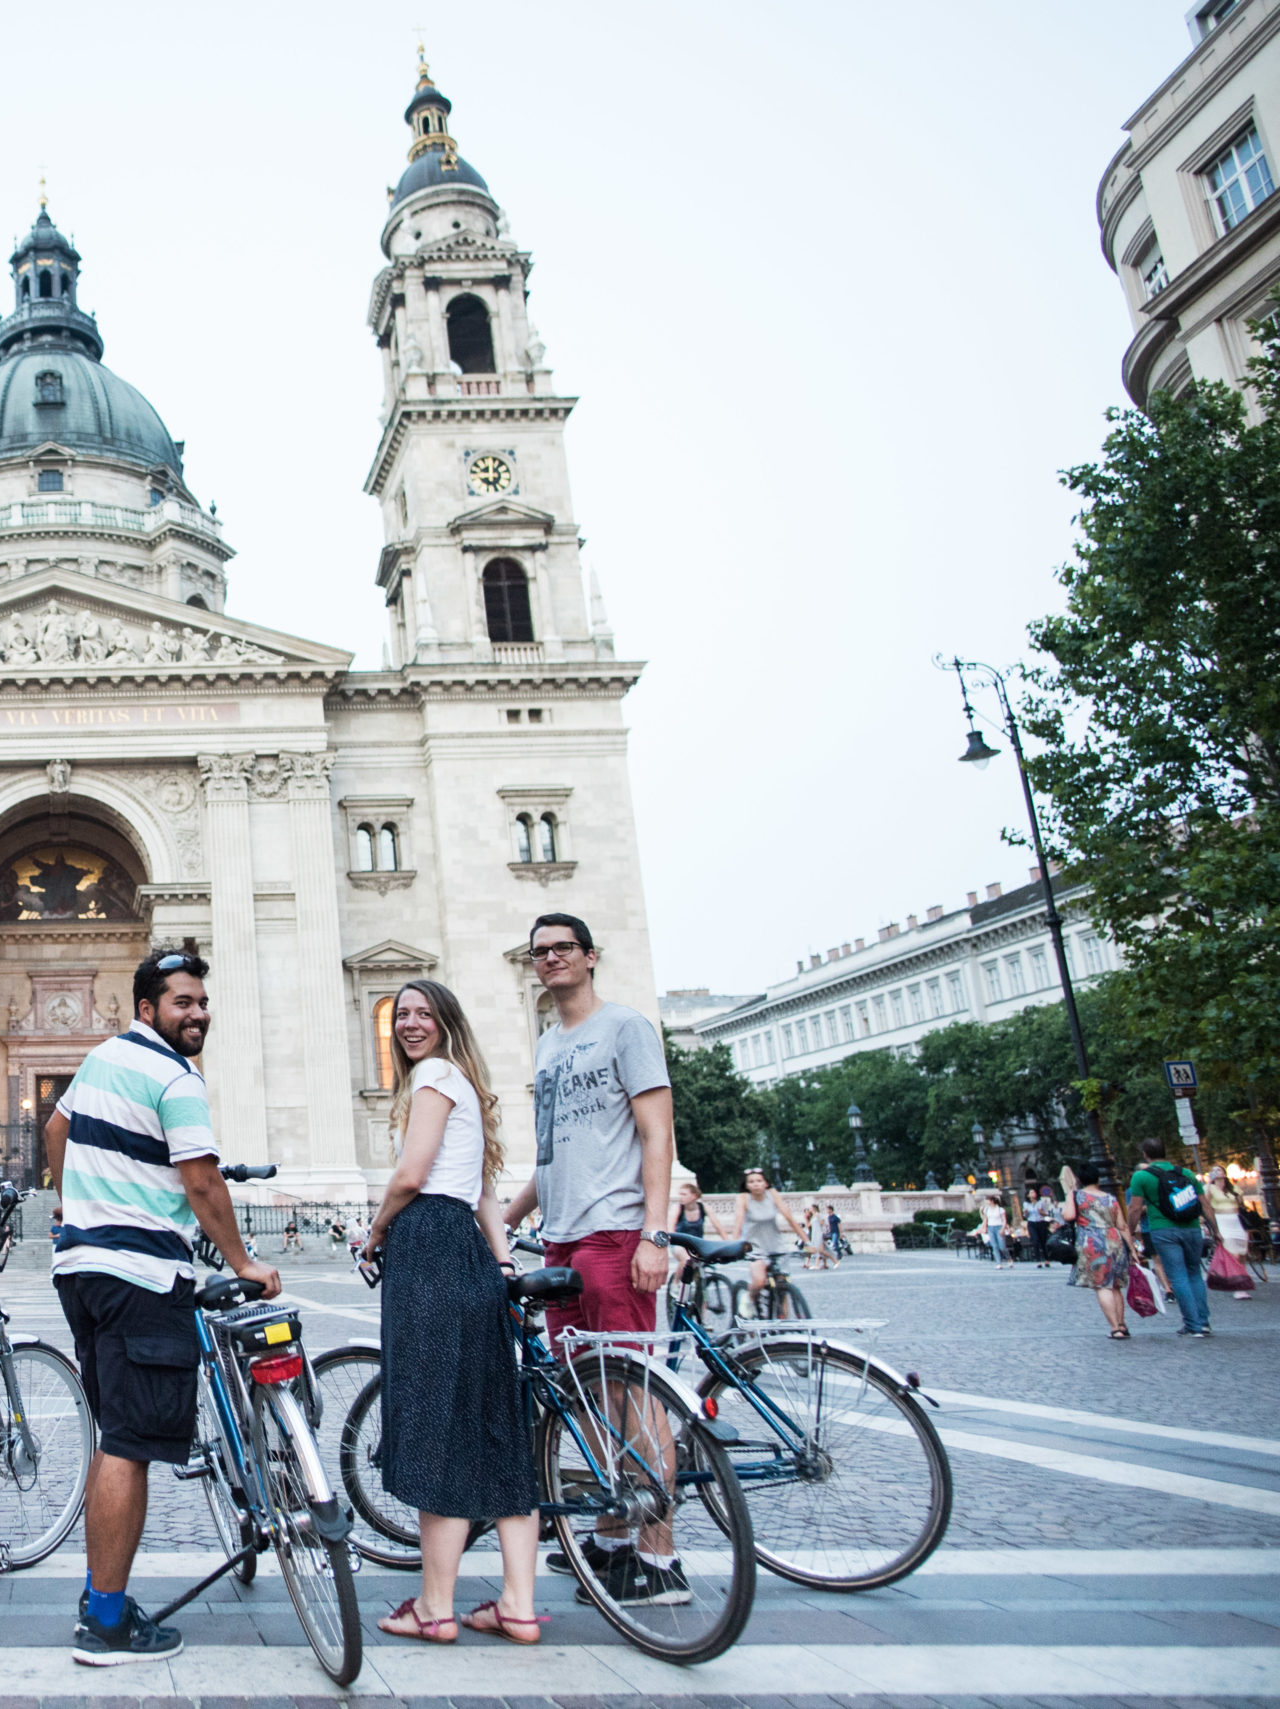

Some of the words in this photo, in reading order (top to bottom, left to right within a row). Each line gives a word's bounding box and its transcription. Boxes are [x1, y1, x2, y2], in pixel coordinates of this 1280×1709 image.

[6, 710, 39, 726] VIA
[51, 708, 131, 724] VERITAS
[142, 707, 166, 722] ET
[176, 706, 218, 721] VITA
[1172, 1184, 1198, 1209] NIKE
